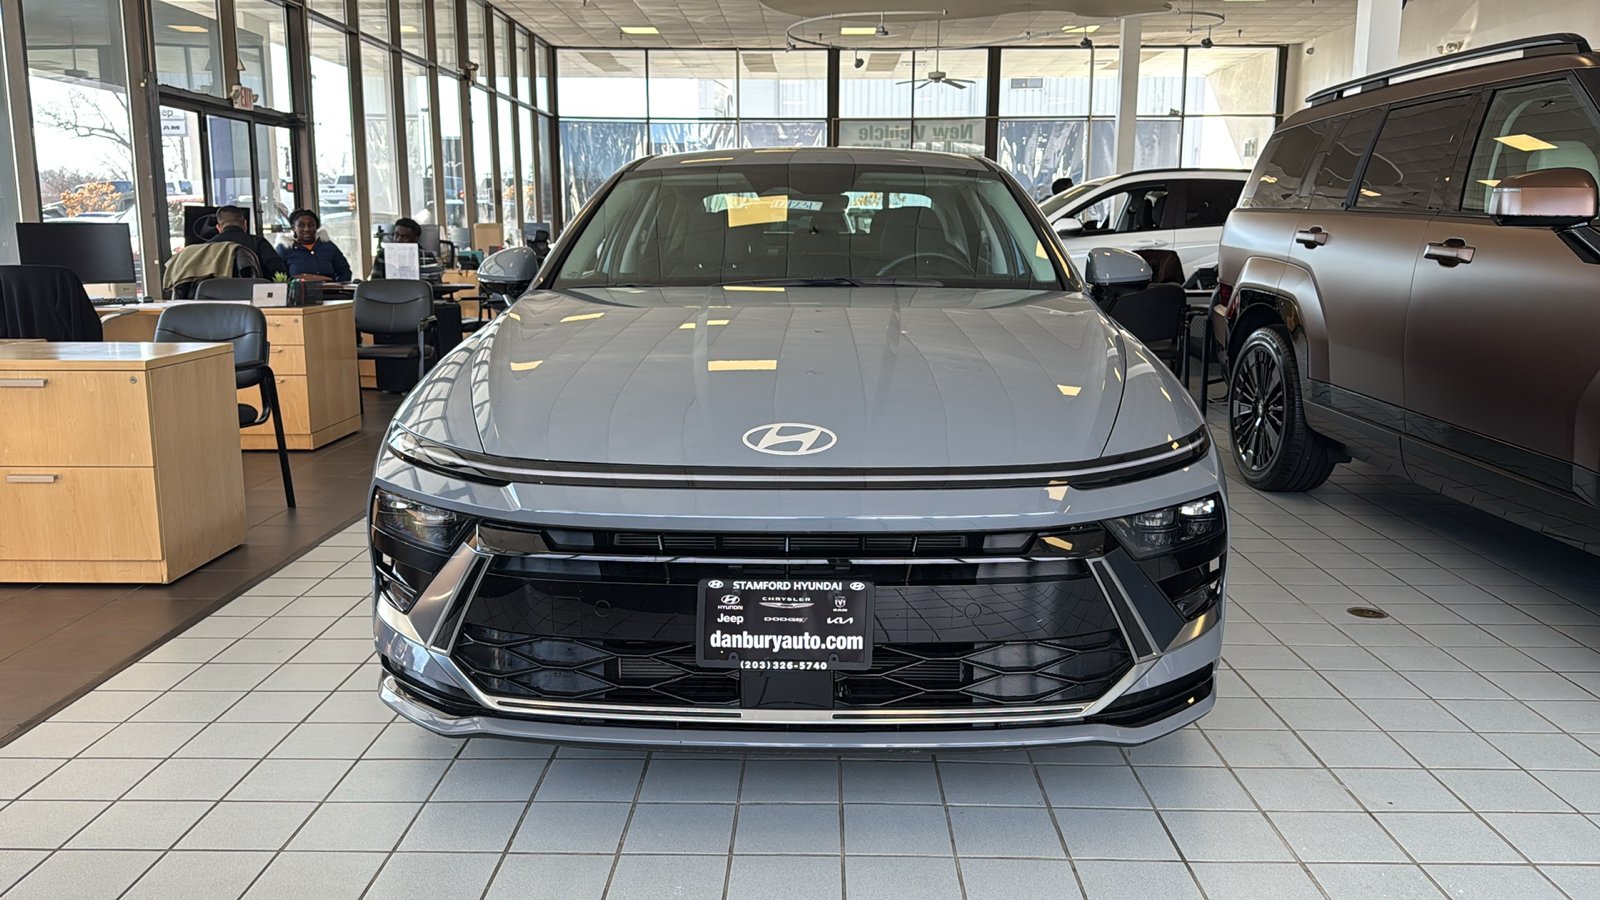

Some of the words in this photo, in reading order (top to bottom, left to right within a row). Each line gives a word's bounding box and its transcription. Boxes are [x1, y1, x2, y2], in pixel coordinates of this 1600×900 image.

[240, 87, 252, 108] EXIT
[732, 581, 791, 591] STAMFORD
[793, 581, 842, 592] HYUNDAI
[717, 613, 744, 625] Jeep
[710, 630, 864, 652] danburyauto.com
